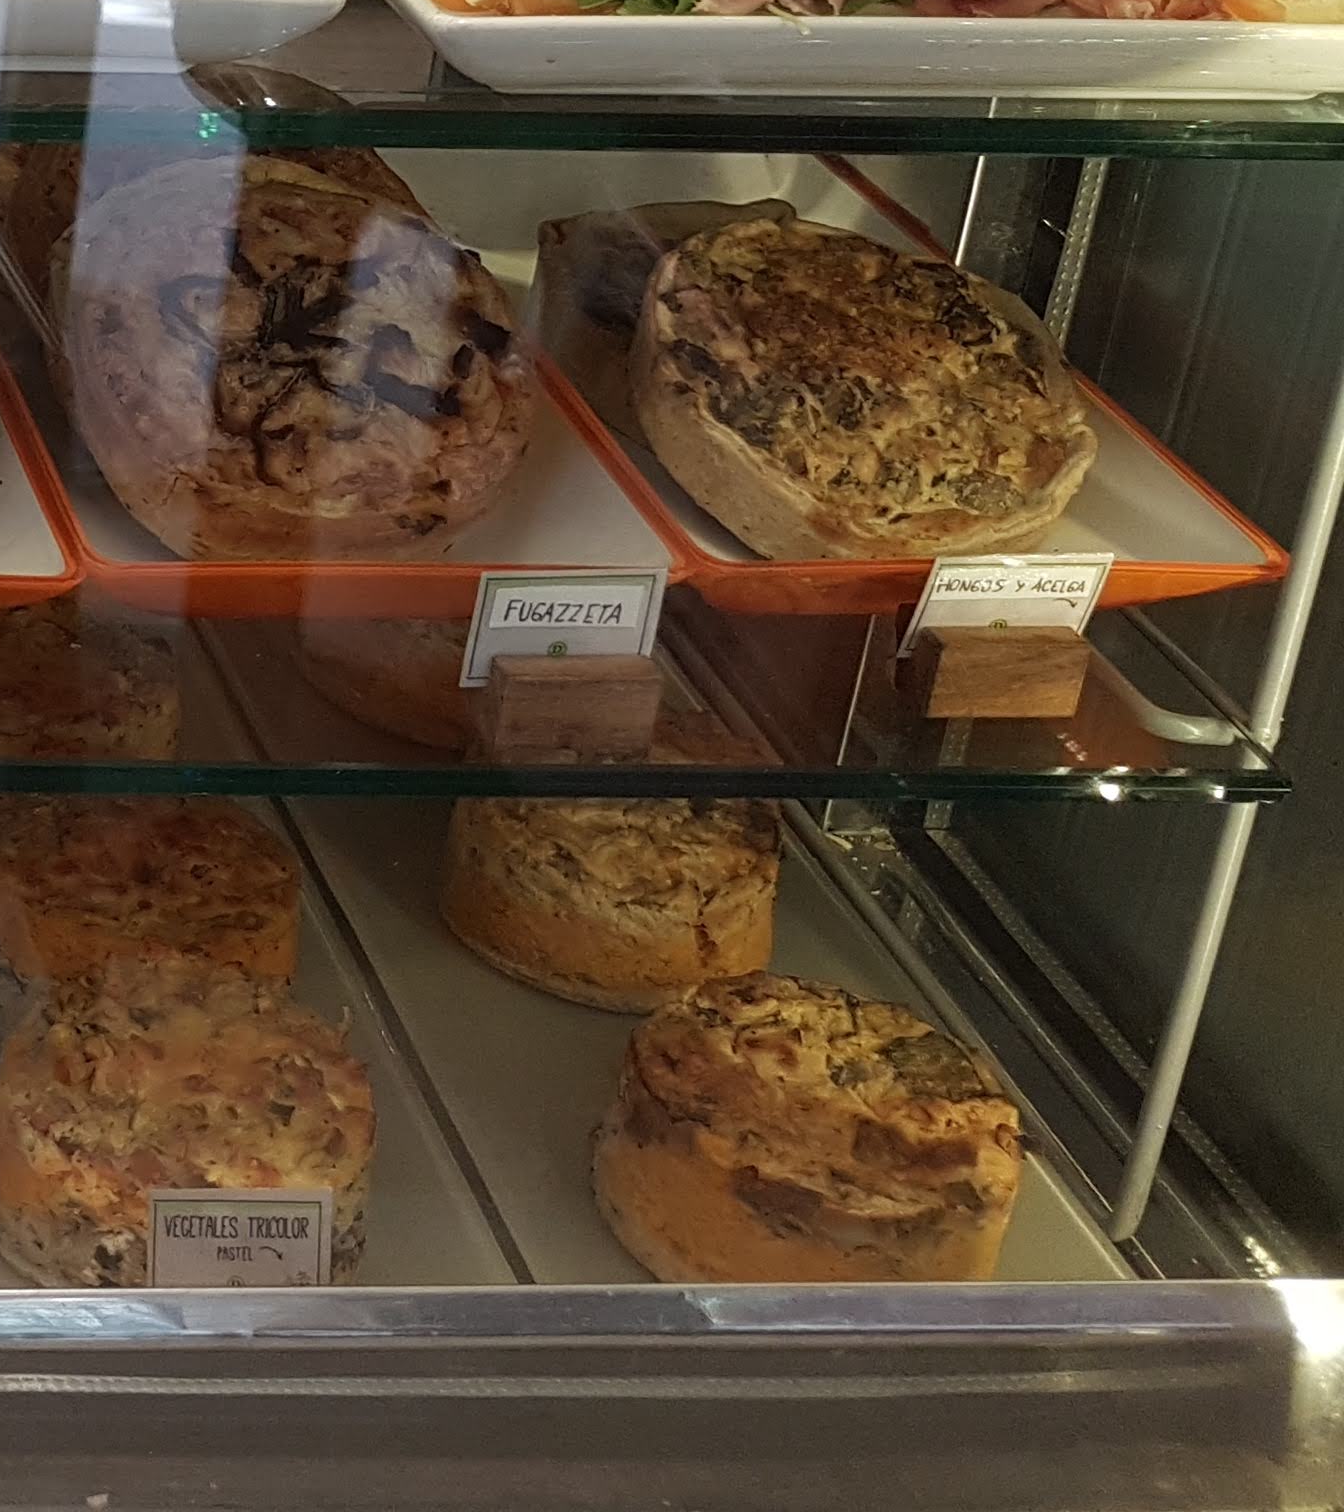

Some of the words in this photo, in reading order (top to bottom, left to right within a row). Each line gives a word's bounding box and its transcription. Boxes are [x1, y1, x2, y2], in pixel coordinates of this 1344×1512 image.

[1031, 578, 1085, 593] ACELGA
[503, 598, 623, 625] FUGAZZETA
[164, 1214, 239, 1239] VEGETALES
[248, 1216, 310, 1239] TRICOLOR
[216, 1245, 255, 1262] PASTEL
